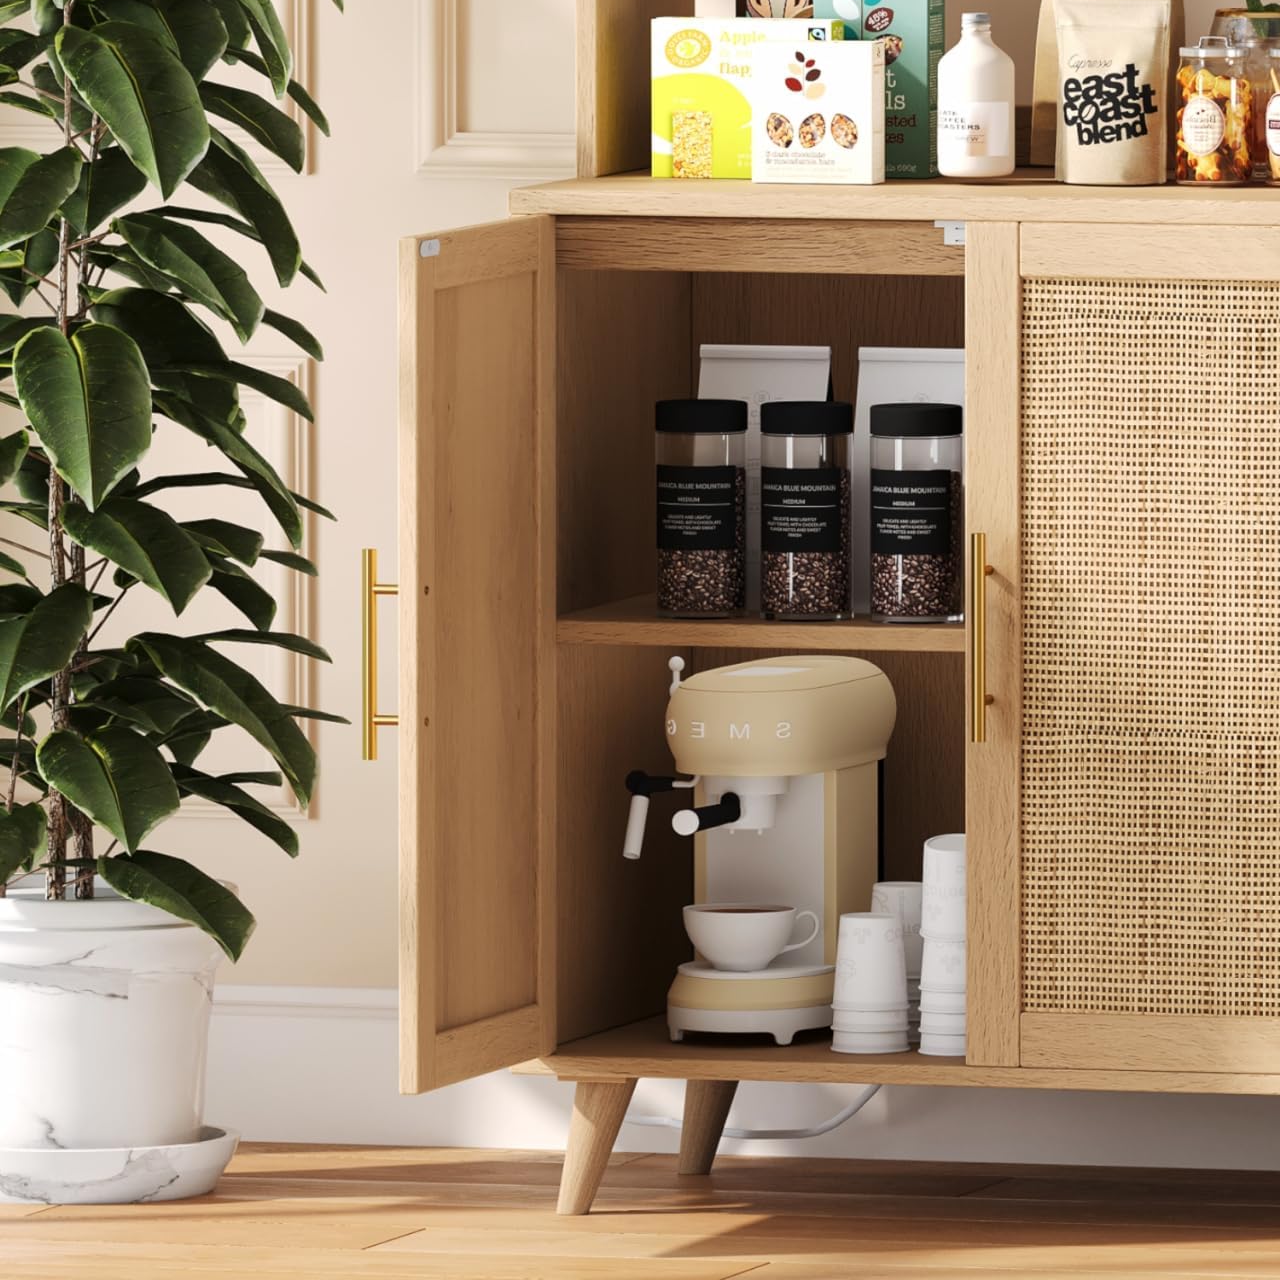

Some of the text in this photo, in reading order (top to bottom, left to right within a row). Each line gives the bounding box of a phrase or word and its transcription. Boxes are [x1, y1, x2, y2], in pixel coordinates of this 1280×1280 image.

[720, 31, 766, 46] Apple
[1064, 63, 1140, 103] east
[1063, 84, 1158, 126] coast
[1076, 114, 1148, 146] blend
